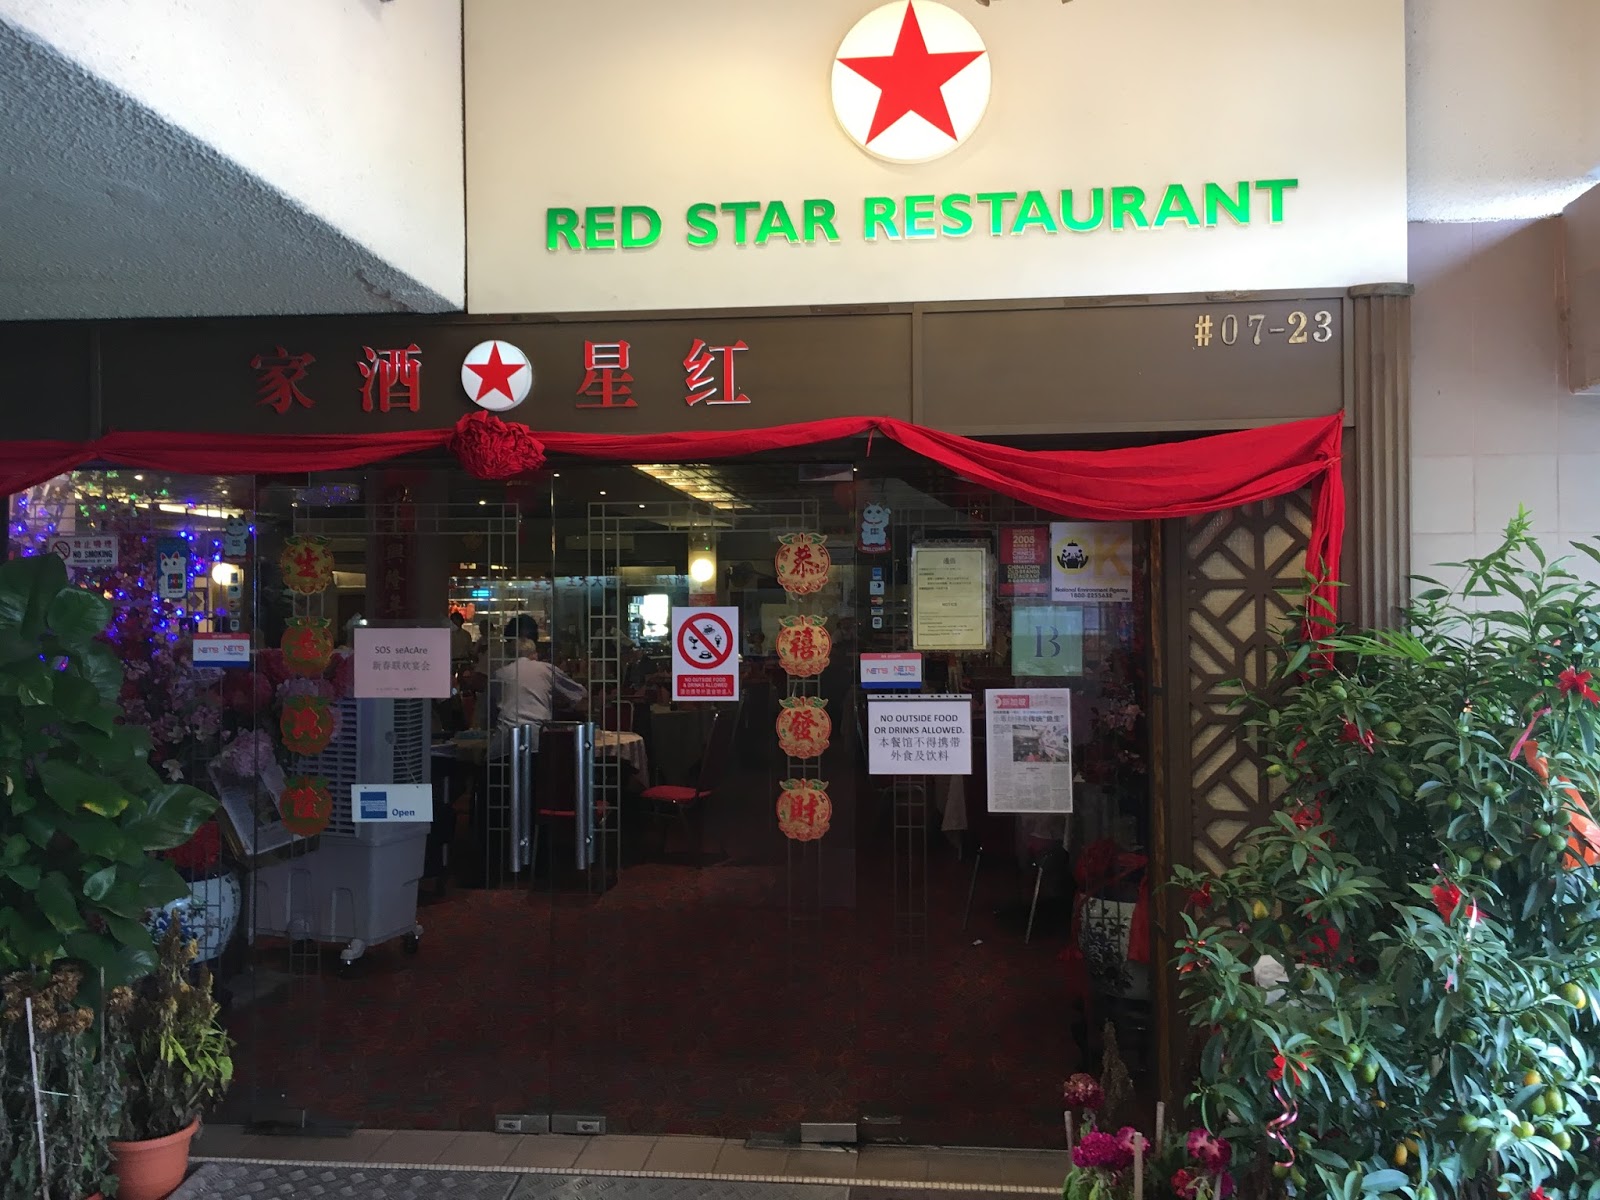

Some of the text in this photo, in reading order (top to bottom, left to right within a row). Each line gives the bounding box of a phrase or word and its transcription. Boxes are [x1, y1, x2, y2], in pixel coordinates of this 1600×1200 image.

[547, 178, 1299, 251] RED STAR RESTAURANT
[1194, 310, 1332, 347] #07-23
[1013, 535, 1035, 544] 2008
[73, 550, 113, 559] NO SMOKING
[1034, 625, 1061, 658] B
[198, 646, 219, 654] NETS
[375, 646, 428, 654] SOS seAcAre
[866, 667, 889, 675] NETS
[880, 714, 959, 723] NO OUTSIDE FOOD
[873, 726, 965, 734] OR DRINKS ALLOWED.
[878, 736, 961, 748] 本餐馆不得携带
[890, 750, 949, 762] 外食及饮料
[391, 808, 416, 818] Open
